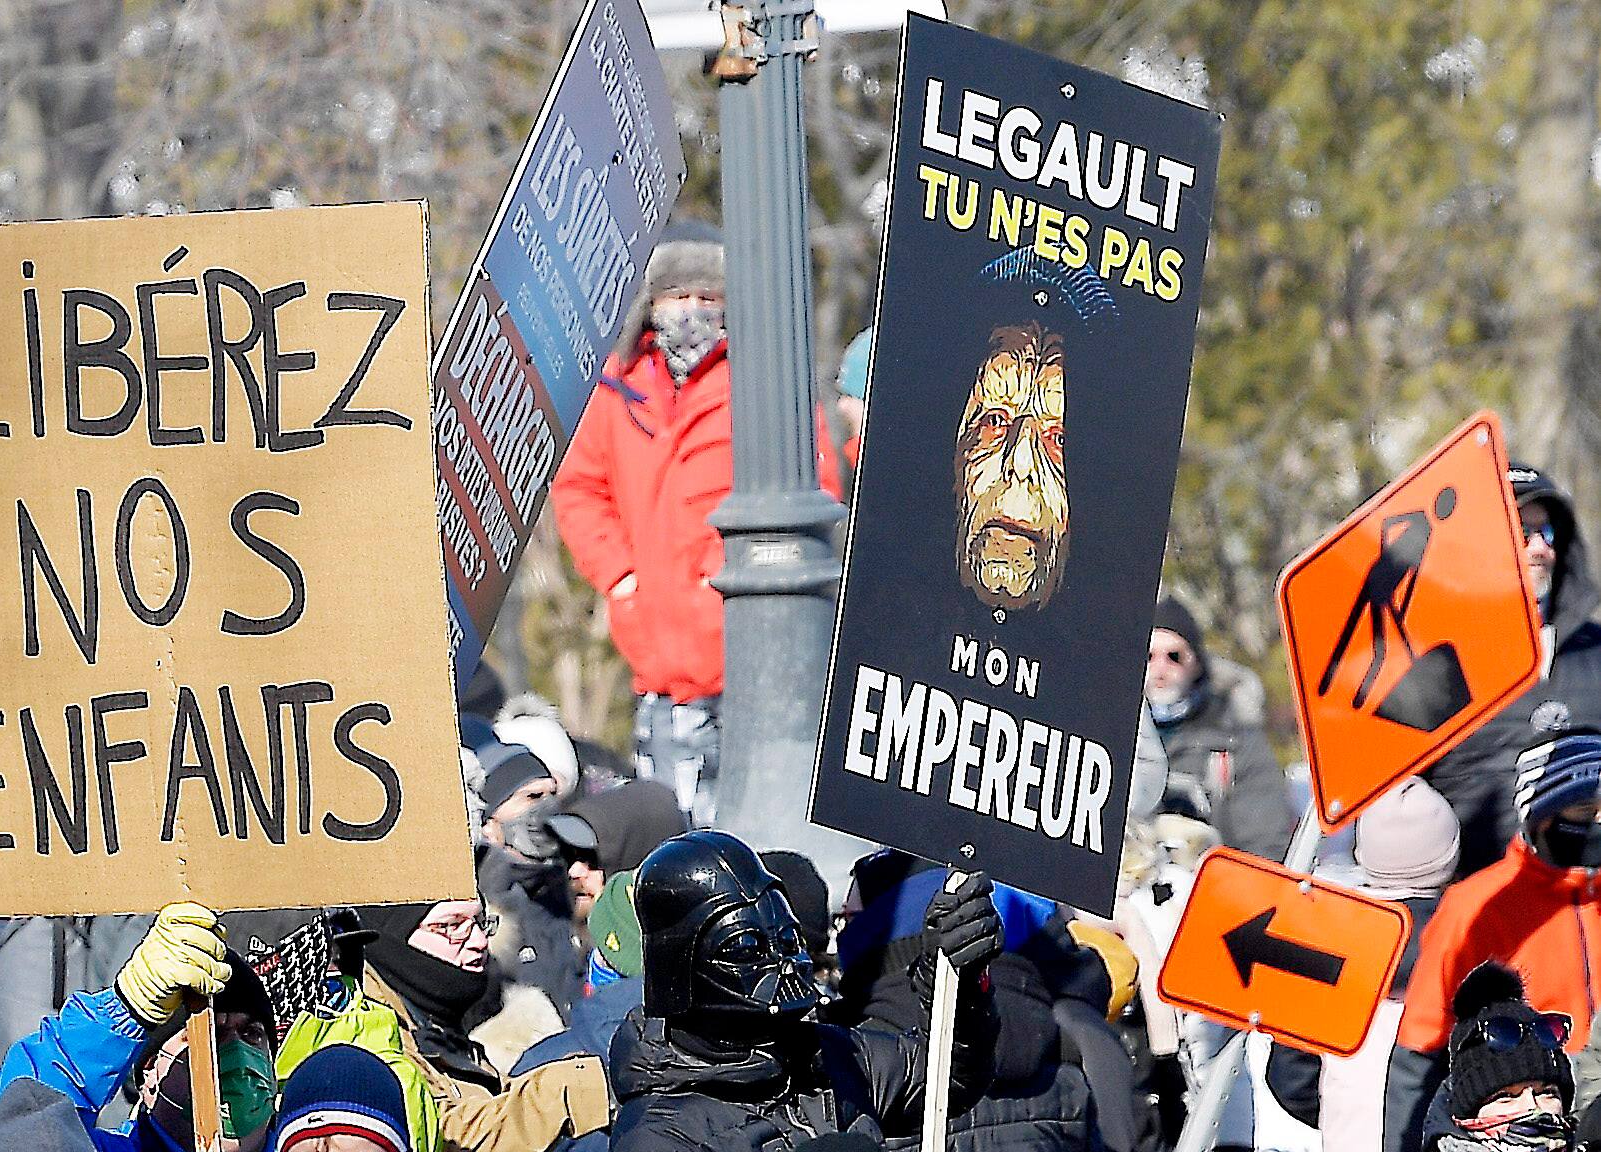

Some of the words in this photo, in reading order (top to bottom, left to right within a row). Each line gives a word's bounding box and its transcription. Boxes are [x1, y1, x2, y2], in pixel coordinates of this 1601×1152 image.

[529, 112, 583, 221] LES
[920, 78, 1196, 231] LEGAULT
[511, 202, 533, 247] DE
[526, 228, 553, 283] NOS
[918, 164, 980, 231] TU
[987, 188, 1091, 270] N'ES
[1099, 227, 1185, 302] PAS
[449, 293, 555, 526] DÉCHARGER
[16, 477, 306, 665] NOS
[436, 475, 481, 580] BUSIVES
[950, 633, 1041, 699] MON
[843, 663, 1113, 855] EMPEREUR
